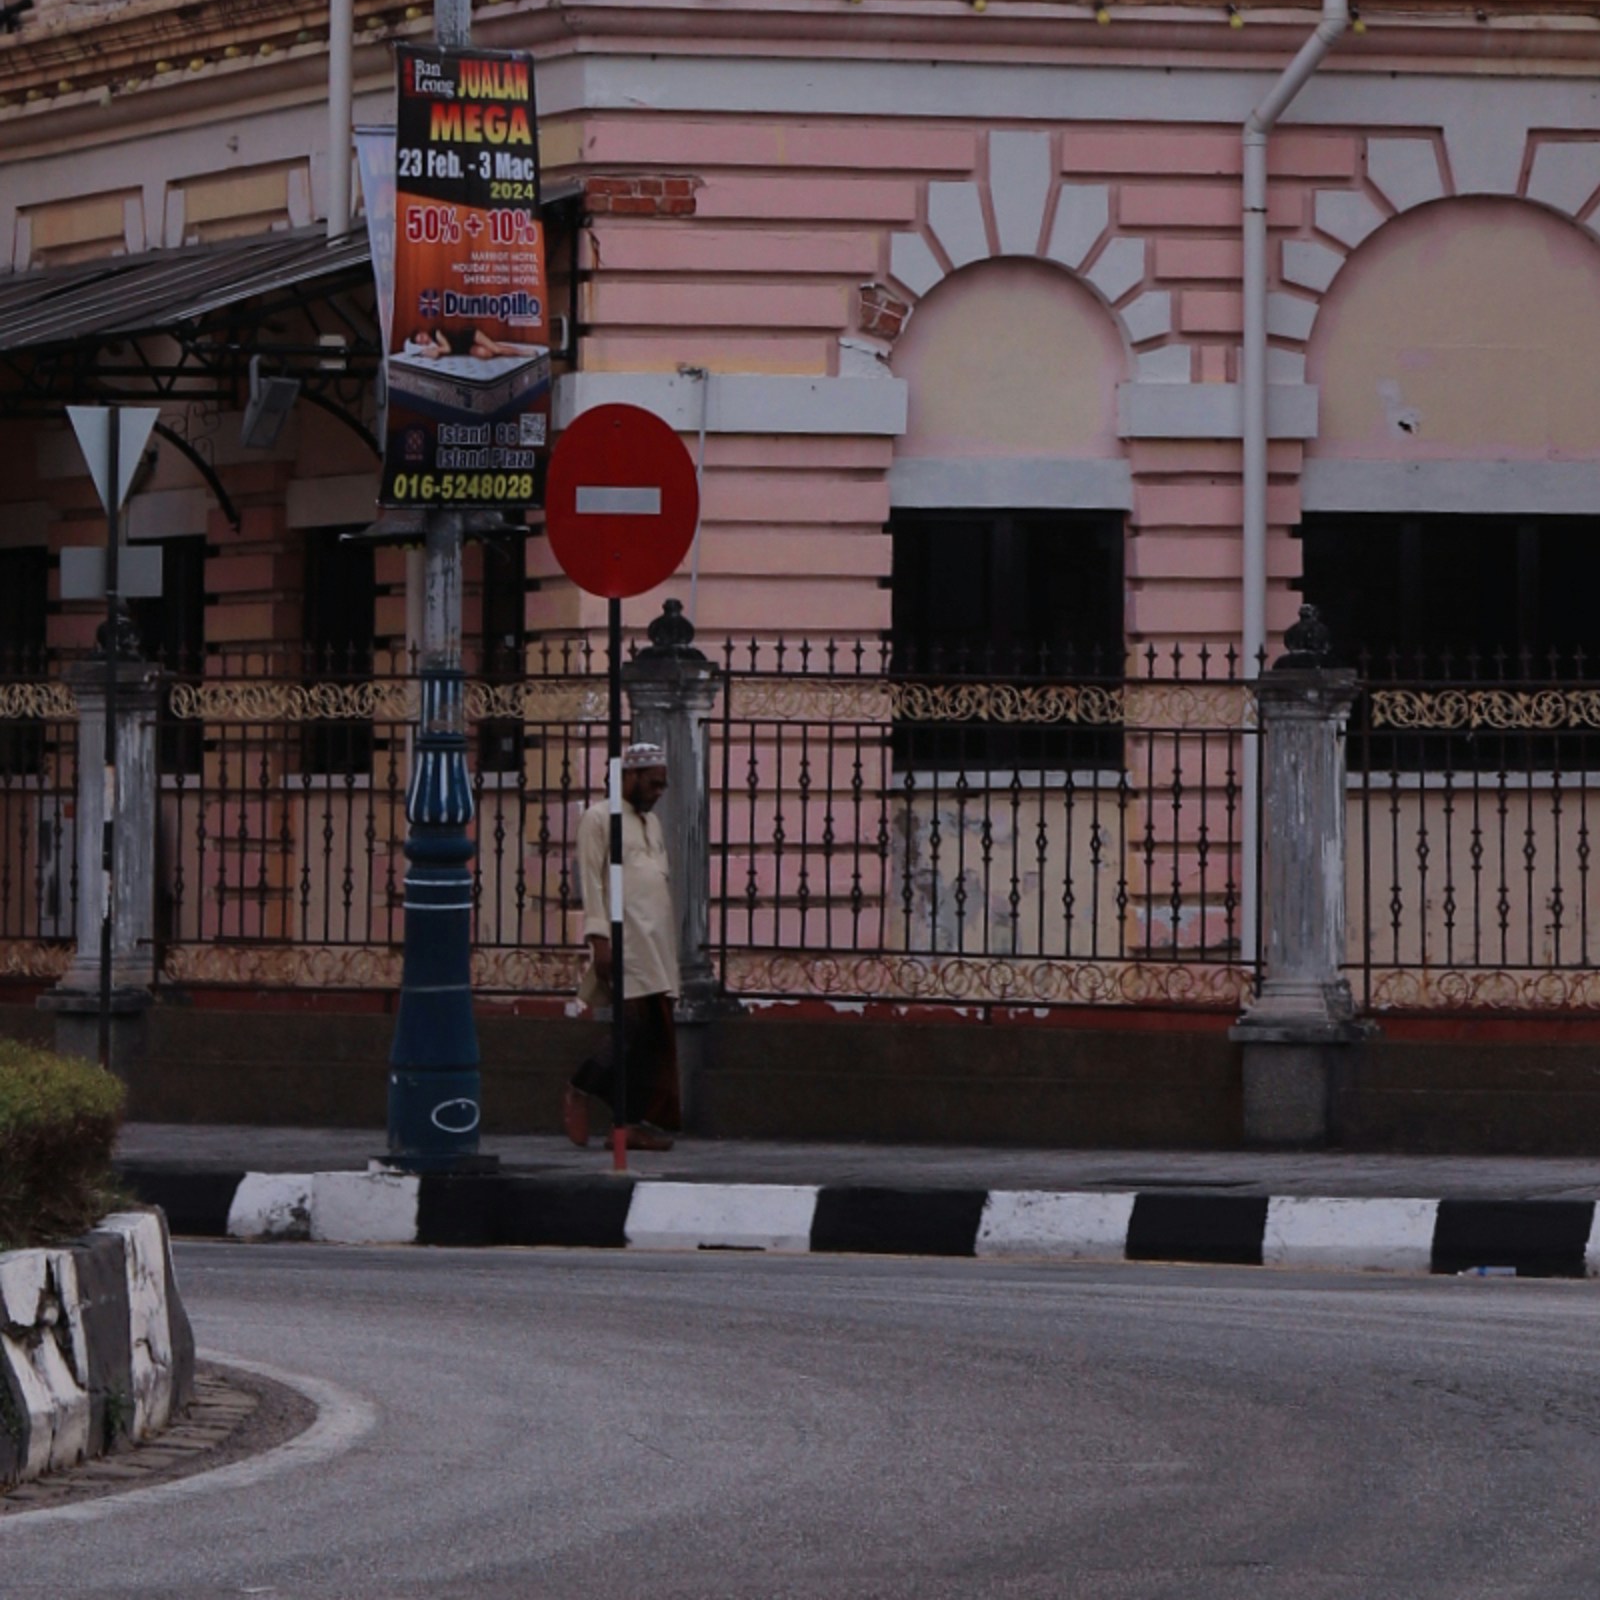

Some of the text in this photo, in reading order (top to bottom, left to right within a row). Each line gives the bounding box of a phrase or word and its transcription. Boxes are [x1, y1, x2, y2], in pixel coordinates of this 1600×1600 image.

[415, 59, 441, 76] Ban
[415, 76, 455, 98] Leong
[458, 59, 529, 100] JUALAN
[430, 102, 532, 144] MEGA
[399, 148, 422, 177] 23
[427, 149, 464, 178] Feb.
[479, 151, 491, 179] 3
[495, 152, 535, 181] Mac
[490, 182, 535, 199] 2024
[406, 205, 461, 244] 50%
[465, 213, 483, 238] +
[487, 208, 538, 245] 10%
[512, 252, 538, 262] HOTEL
[512, 263, 539, 273] HOTEL
[464, 274, 539, 285] SHERATON HOTEL
[444, 290, 541, 321] Dunlopillo
[438, 423, 490, 444] Island
[436, 446, 535, 469] Island Plaza
[394, 474, 533, 499] 016-5248028
